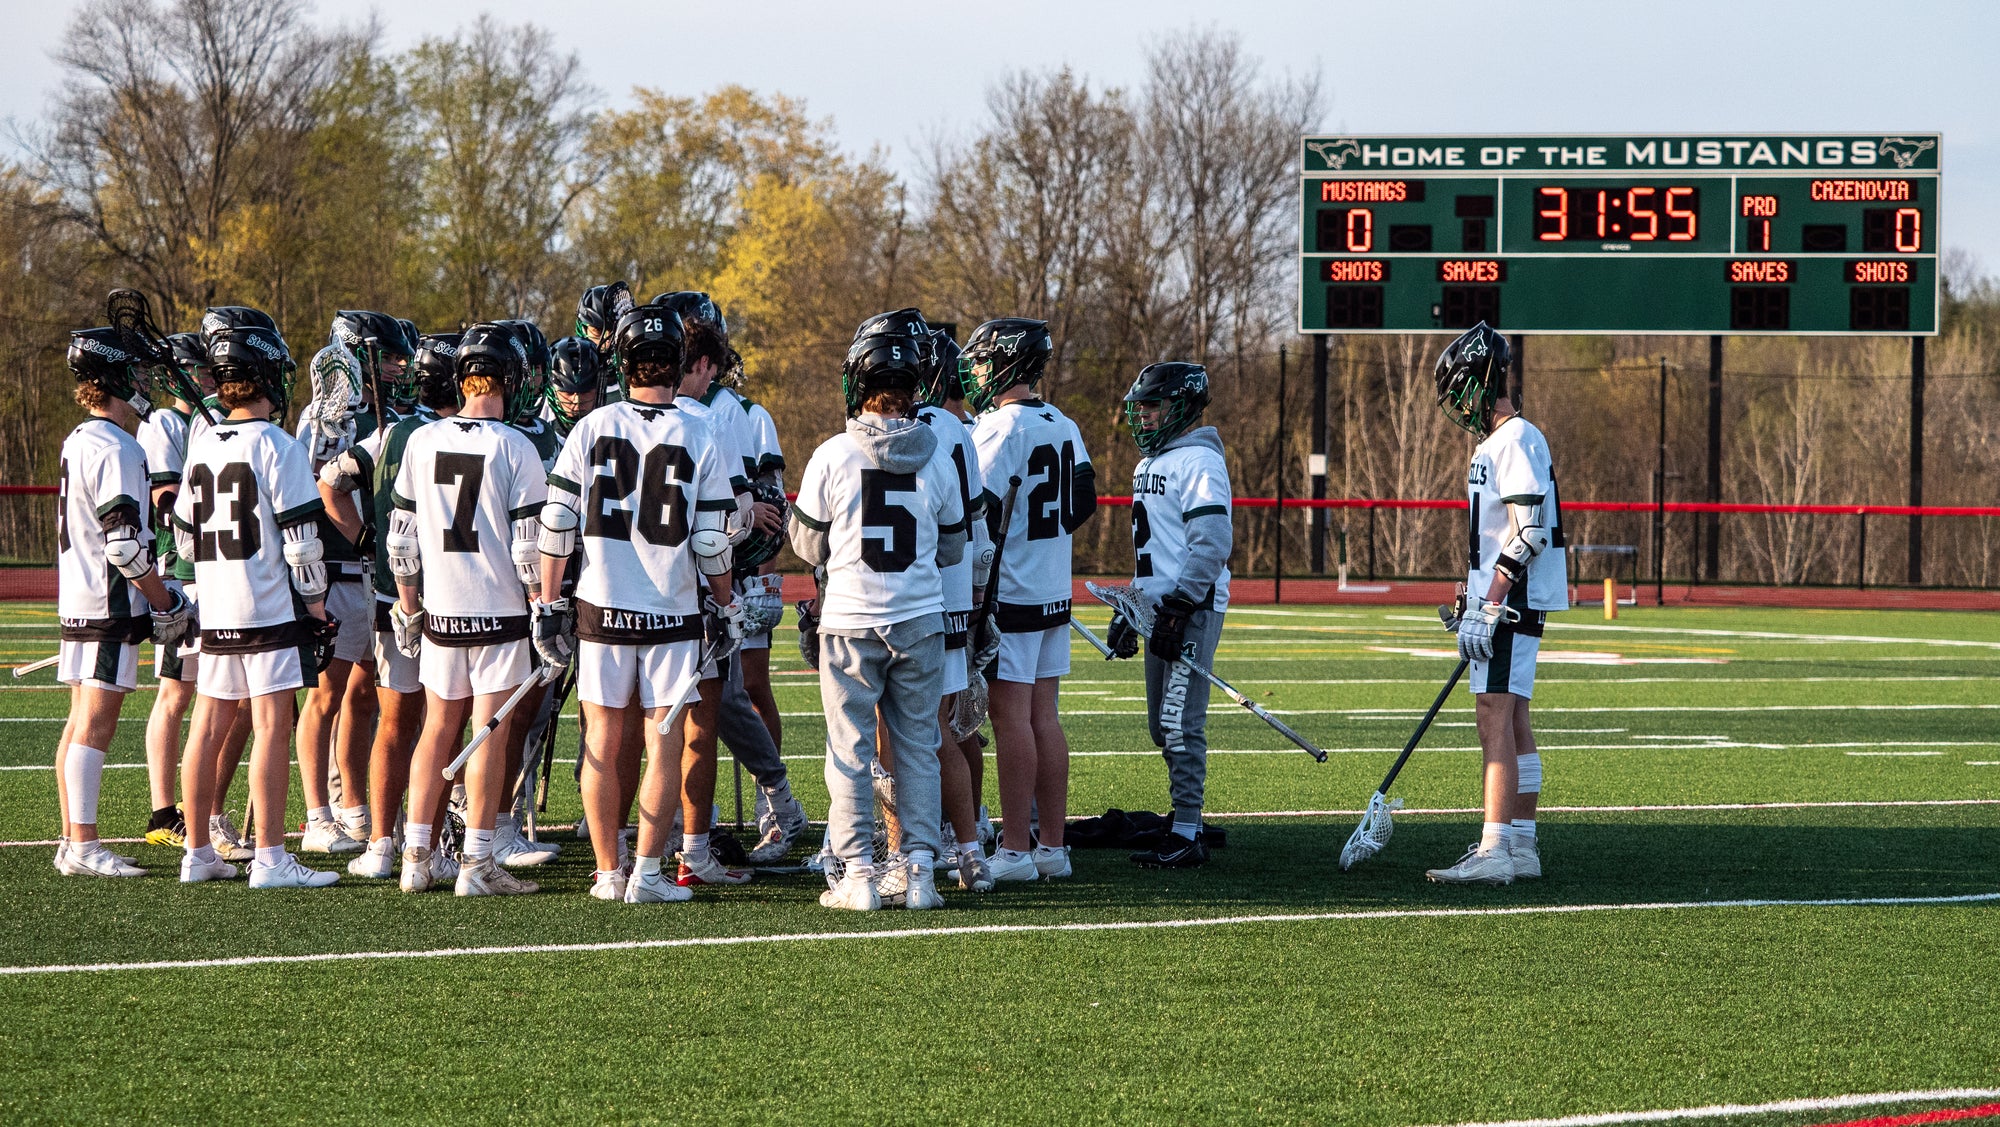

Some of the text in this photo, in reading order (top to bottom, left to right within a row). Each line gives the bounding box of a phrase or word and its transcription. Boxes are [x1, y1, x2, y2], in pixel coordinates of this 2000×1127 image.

[1625, 140, 1877, 165] MUSTANGS
[1322, 181, 1407, 202] MUSTANGS
[1811, 180, 1910, 201] CAZENOVIA
[1540, 187, 1696, 241] 31:55
[1743, 196, 1777, 217] PRD
[1347, 208, 1372, 252] 0
[1763, 219, 1770, 251] 1
[1895, 207, 1920, 252] 0
[1331, 261, 1382, 281] SHOTS
[1442, 261, 1499, 282] SAVES
[1731, 262, 1788, 282] SAVES
[1855, 262, 1908, 282] SHOTS
[643, 318, 663, 332] 26
[907, 321, 923, 336] 21
[215, 341, 230, 356] 23
[246, 333, 281, 360] Stangs
[478, 333, 488, 345] 7
[892, 346, 901, 360] 5
[584, 436, 695, 547] 26
[1028, 440, 1075, 541] 20
[189, 462, 262, 561] 23
[434, 451, 485, 553] 7
[861, 469, 916, 572] 5
[429, 616, 502, 635] LAWRENCE
[602, 609, 684, 630] RAYFIELD
